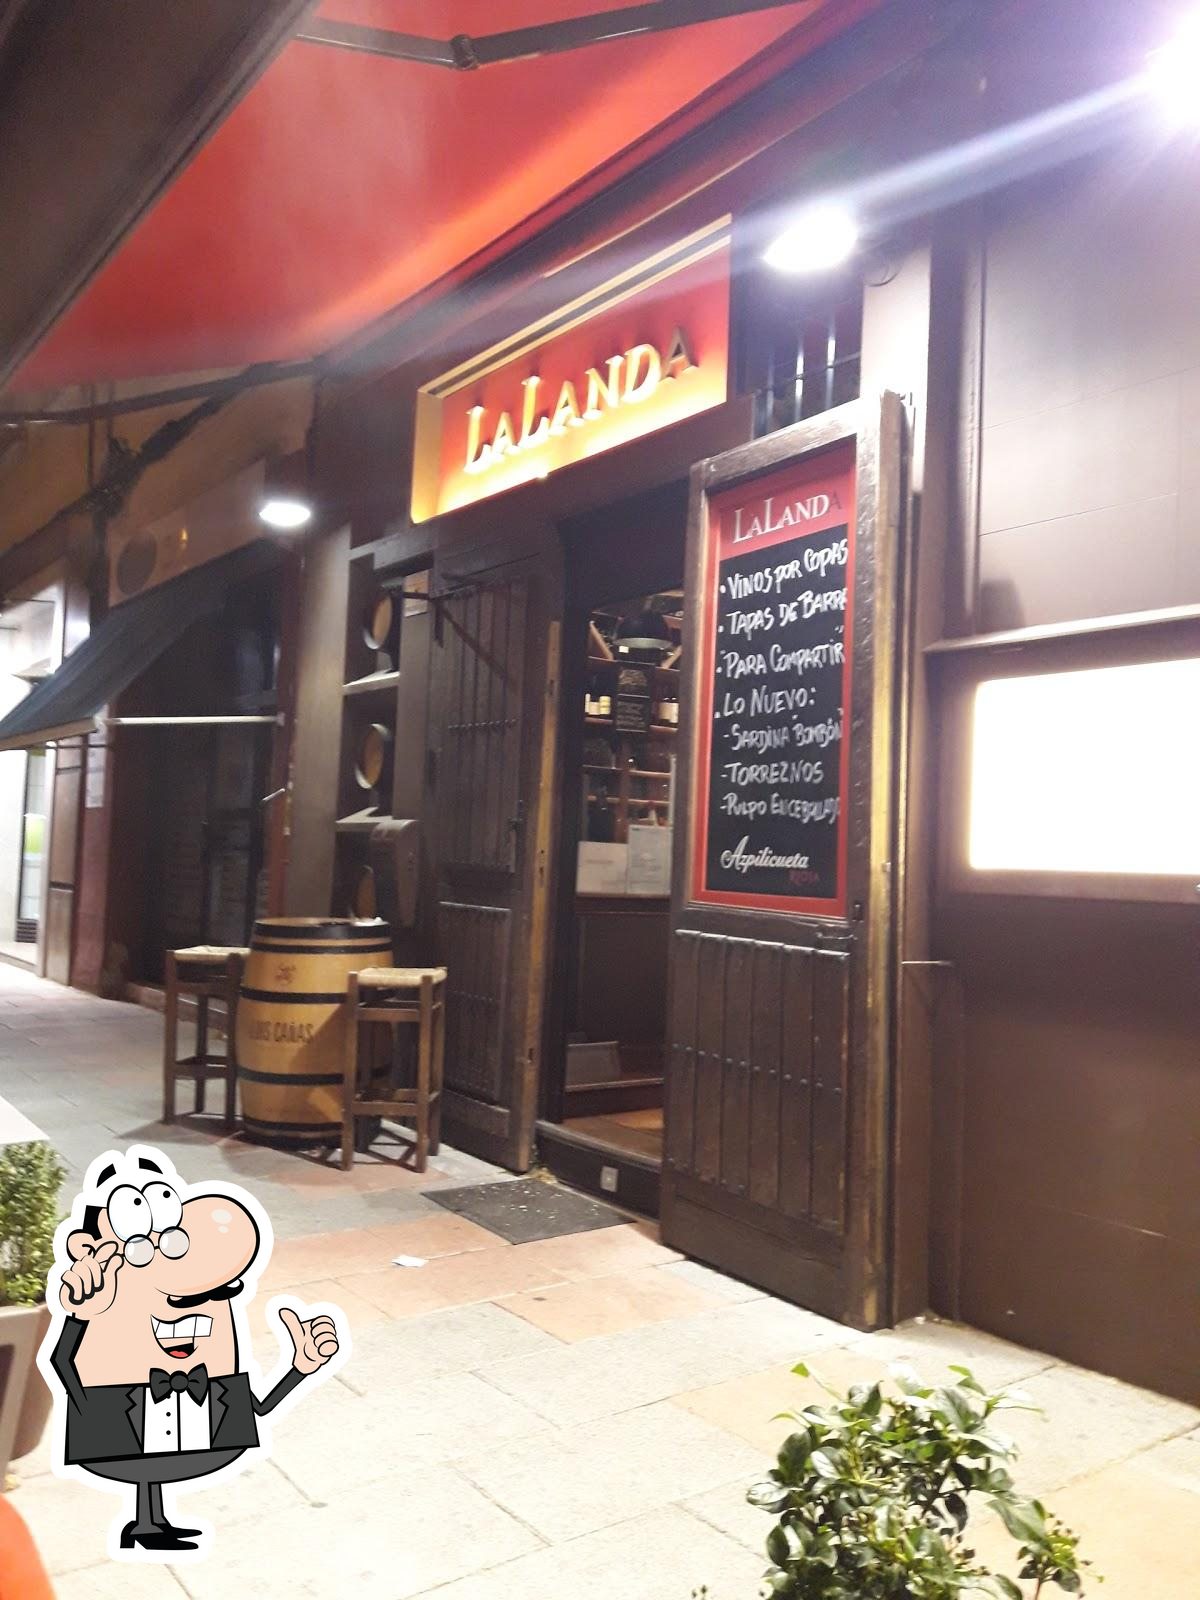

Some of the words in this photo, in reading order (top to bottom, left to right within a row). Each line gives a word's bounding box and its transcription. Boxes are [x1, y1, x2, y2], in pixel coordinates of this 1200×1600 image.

[725, 606, 775, 641] TAPAS
[778, 601, 799, 627] DE
[722, 651, 768, 679] PARA
[723, 692, 746, 717] LO
